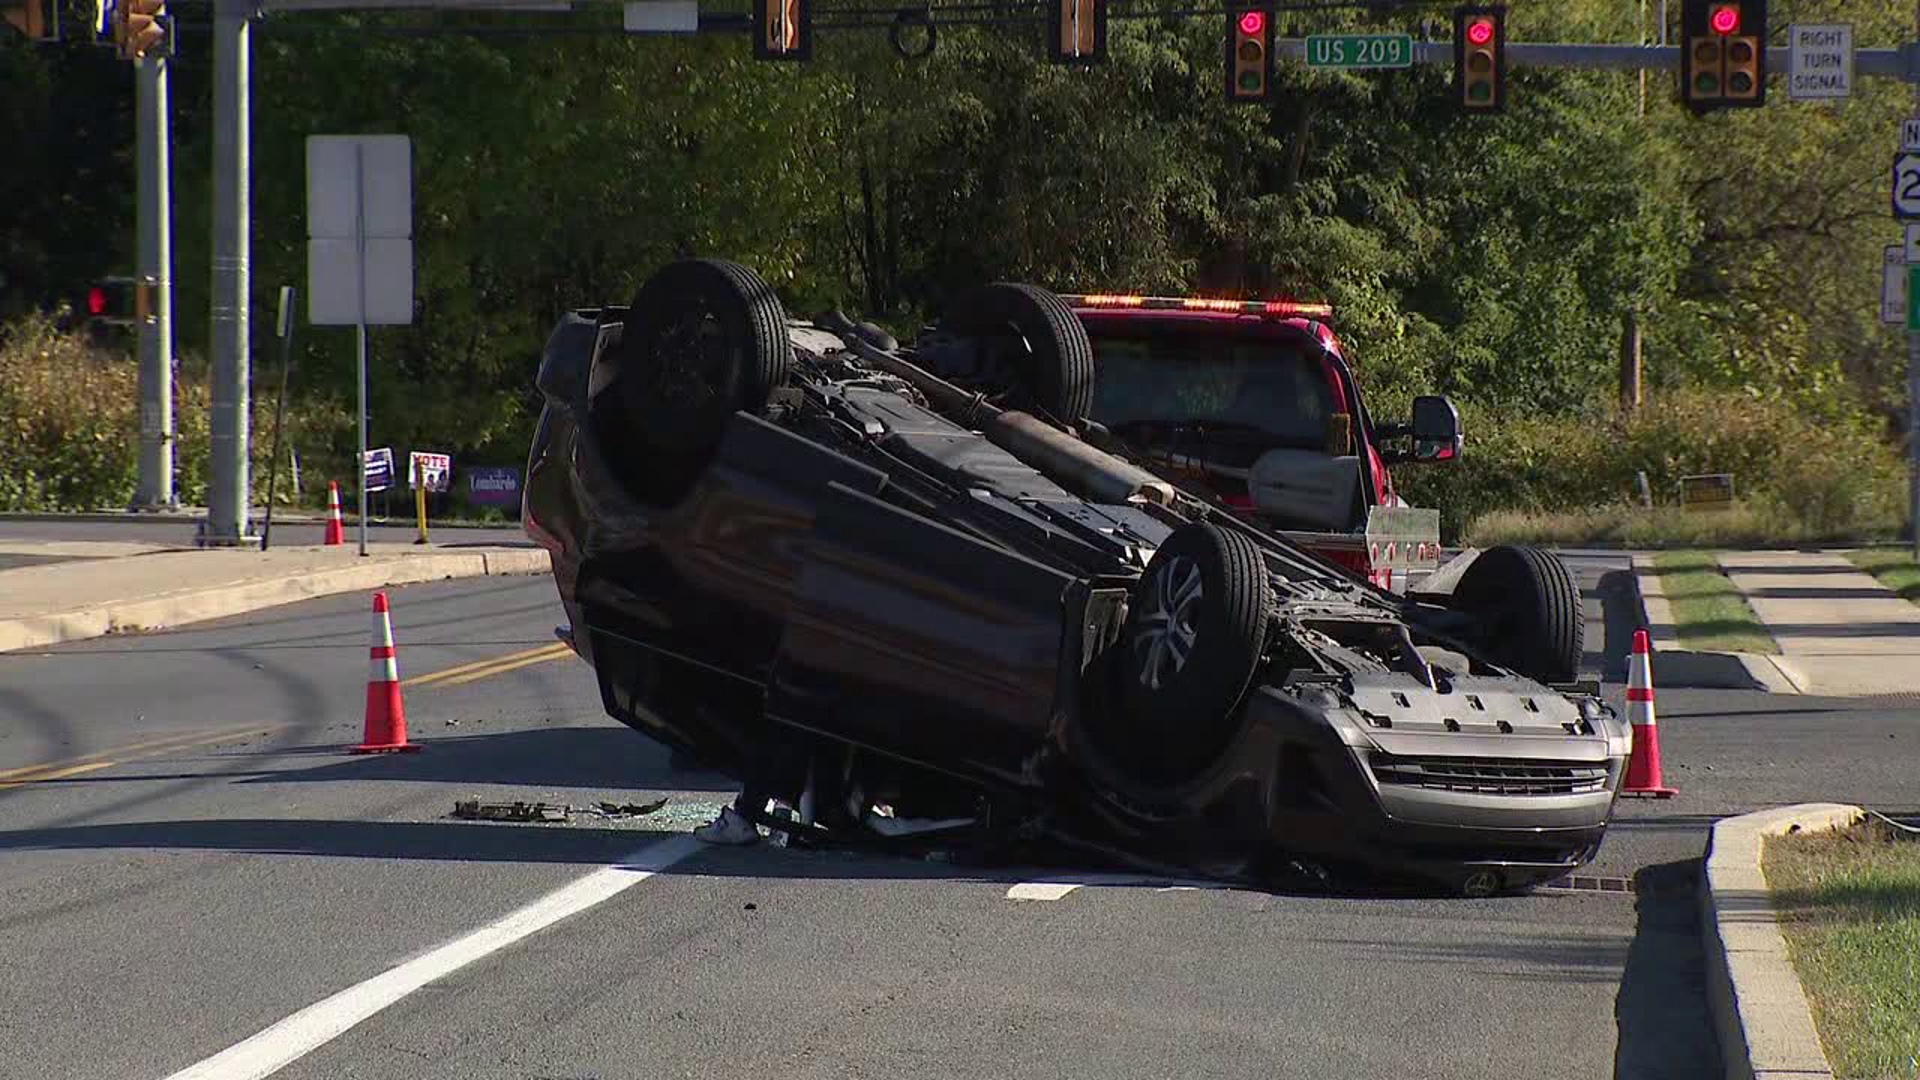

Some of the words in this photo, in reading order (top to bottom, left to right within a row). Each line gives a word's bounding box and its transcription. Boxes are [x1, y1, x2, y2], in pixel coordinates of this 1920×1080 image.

[1800, 31, 1843, 46] RIGHT
[1316, 40, 1344, 63] US
[1356, 40, 1401, 63] 209
[1803, 53, 1842, 68] TURN
[1794, 74, 1848, 90] SIGNAL
[413, 454, 447, 468] VOTE
